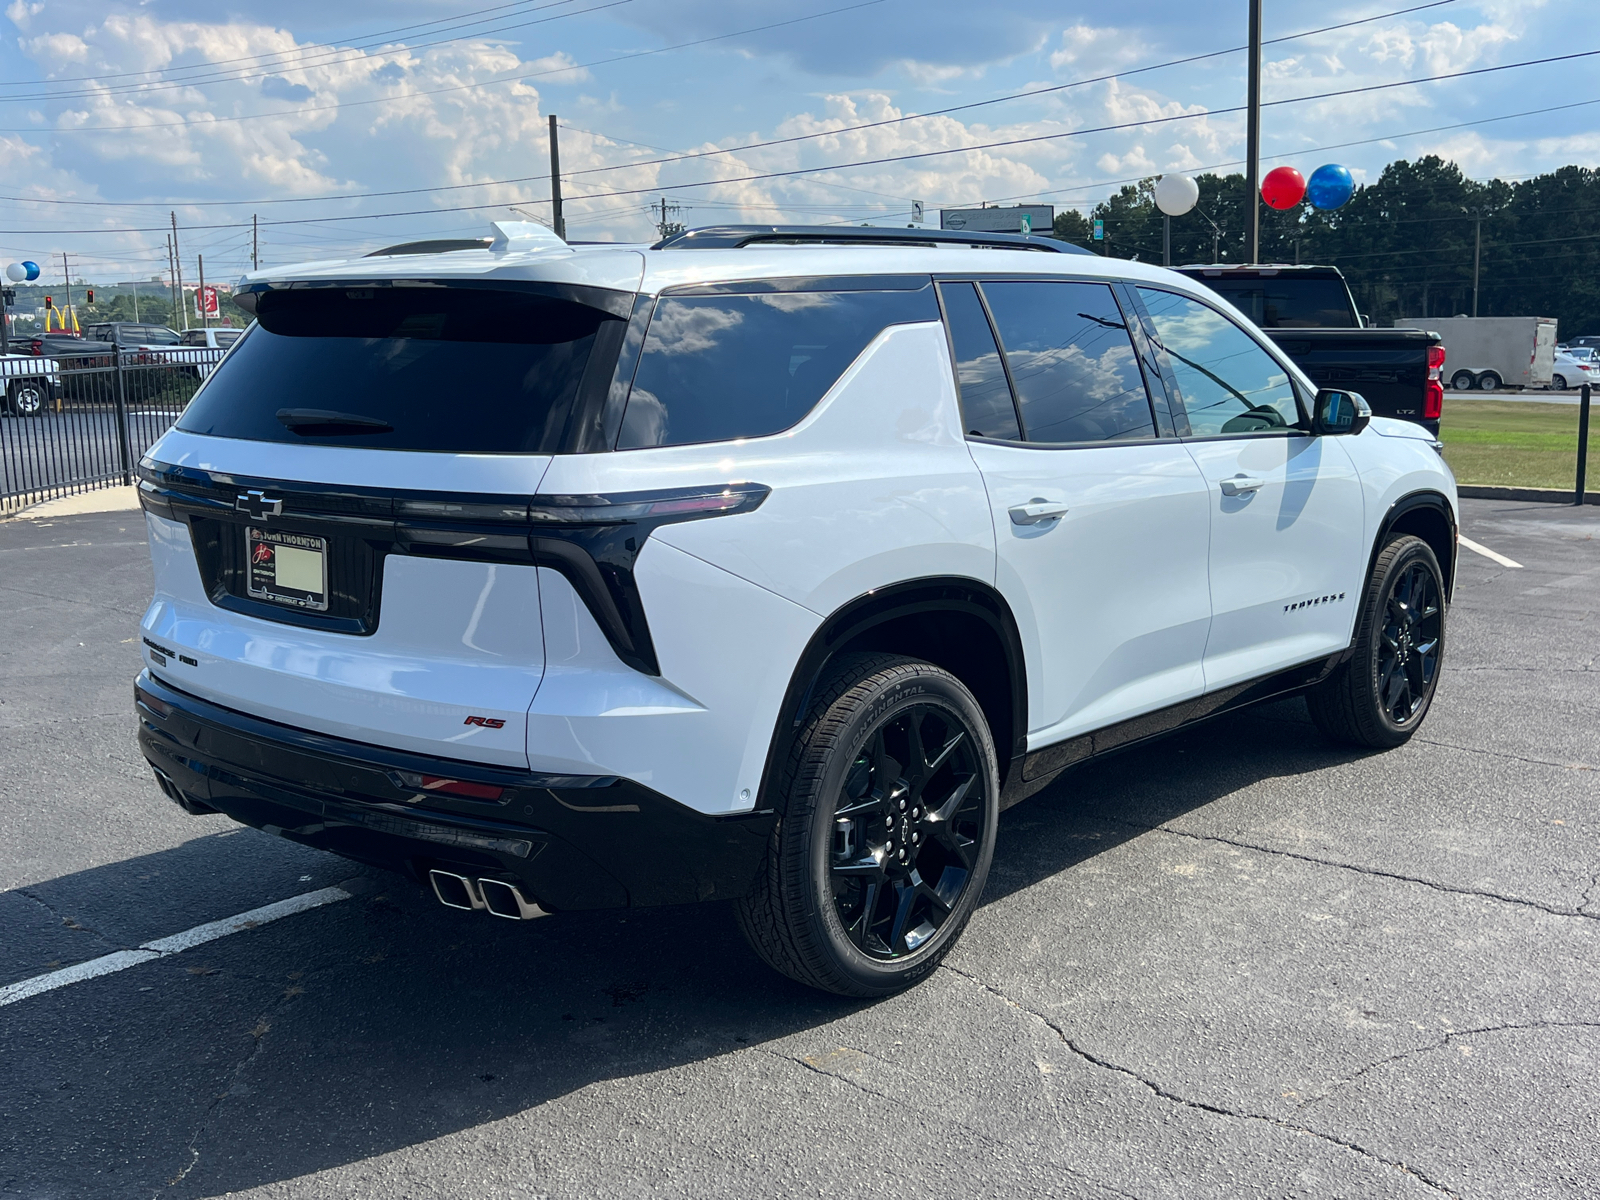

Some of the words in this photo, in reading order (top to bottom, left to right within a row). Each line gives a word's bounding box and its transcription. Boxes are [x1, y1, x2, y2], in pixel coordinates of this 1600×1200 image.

[263, 531, 282, 543] JOHN
[281, 534, 322, 549] THORNTON
[1283, 591, 1346, 612] TRAVERSE
[463, 715, 507, 729] RS
[844, 685, 926, 761] CONTINENTAL
